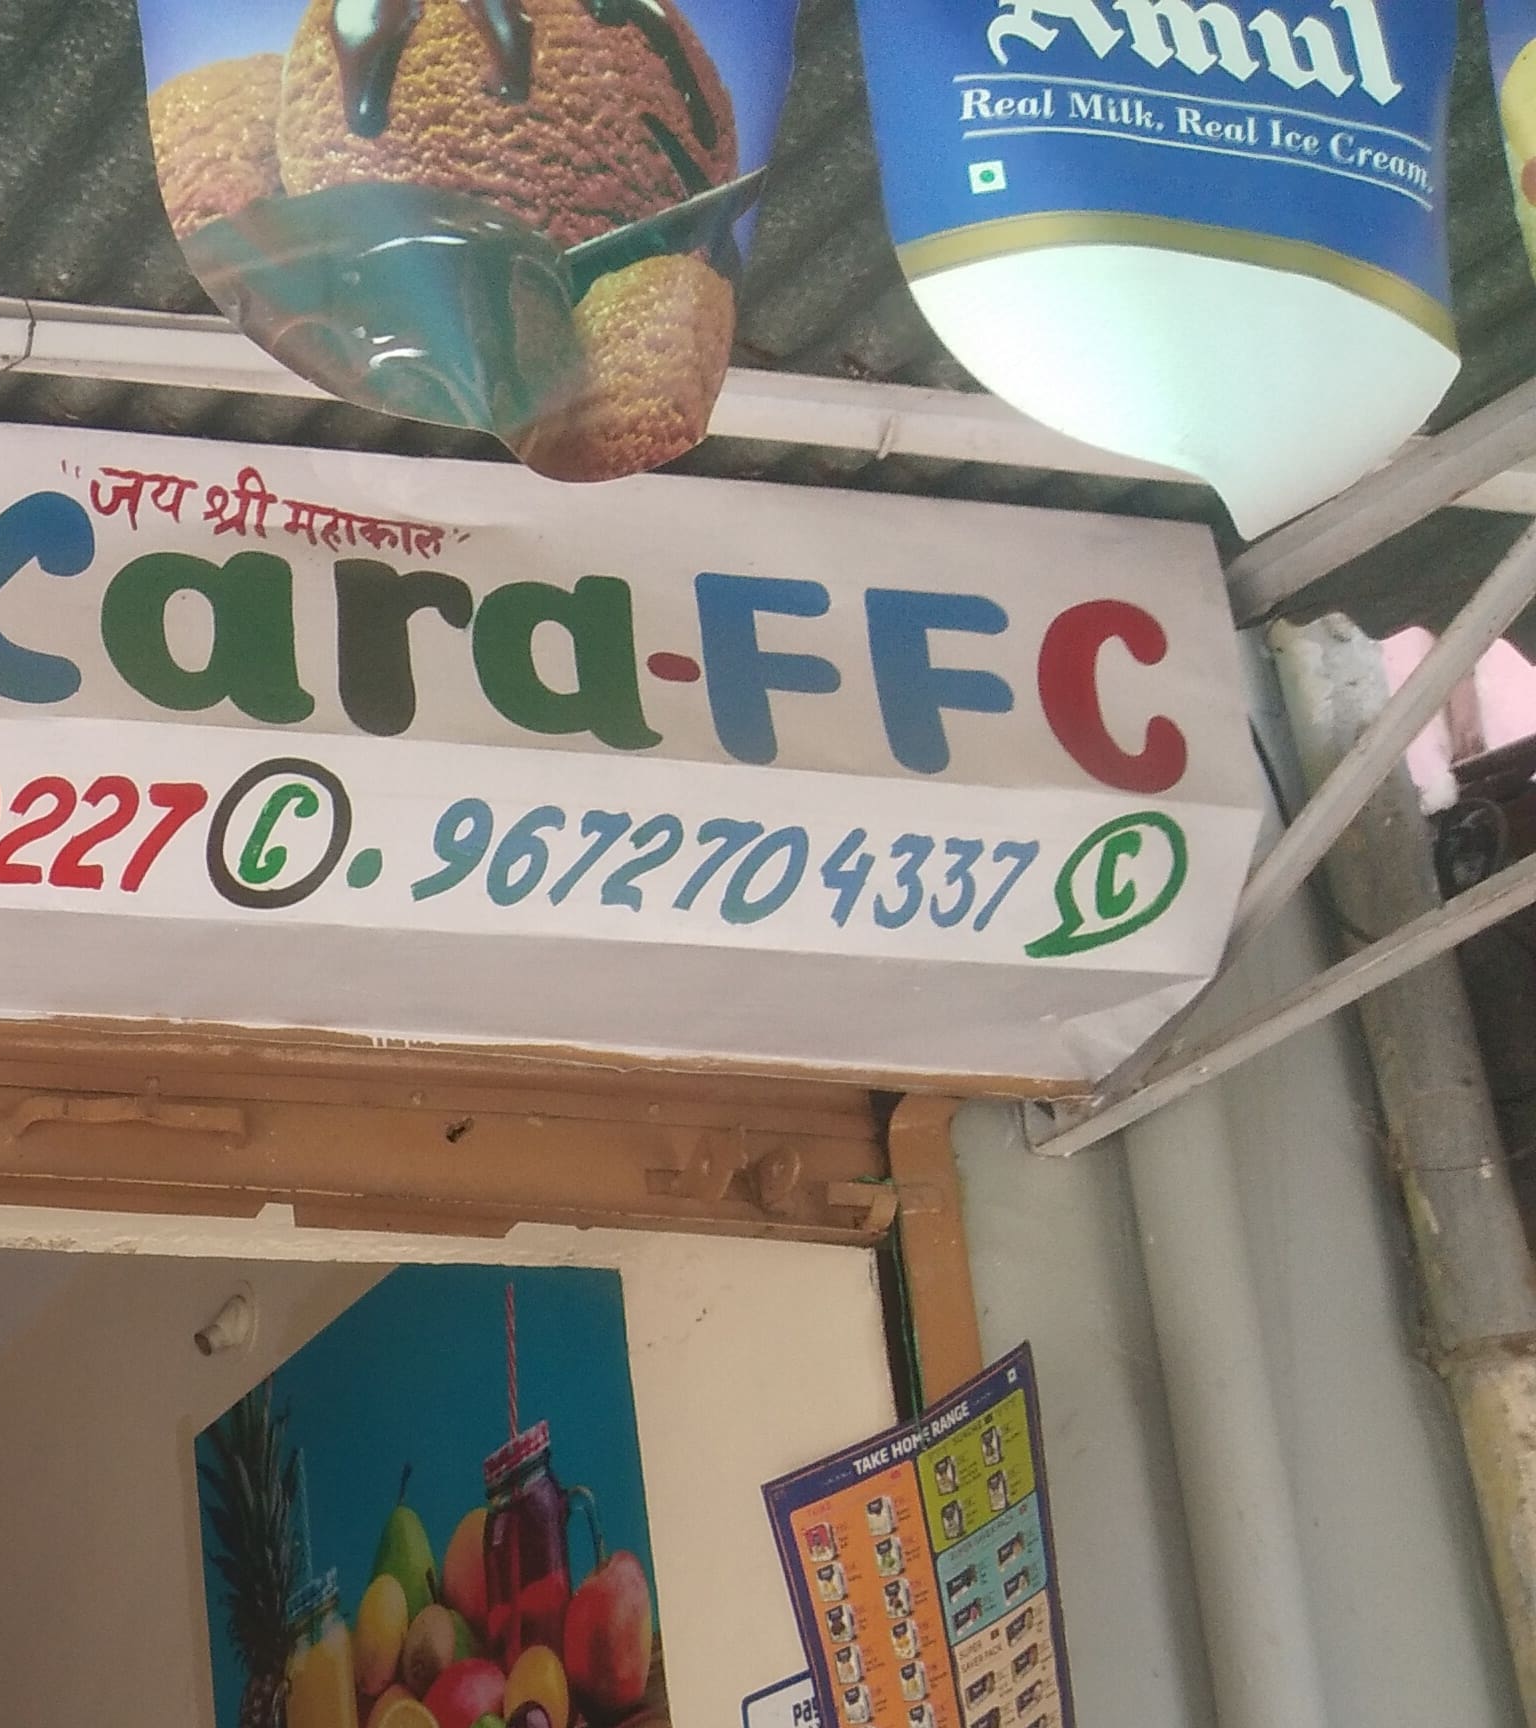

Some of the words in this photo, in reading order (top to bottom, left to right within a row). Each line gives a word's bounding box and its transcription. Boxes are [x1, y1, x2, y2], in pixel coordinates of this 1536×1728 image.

[959, 88, 1055, 120] Real
[1175, 106, 1259, 145] Real
[1268, 119, 1320, 156] Ice
[203, 466, 277, 538] श्री
[412, 798, 1040, 932] 9672704337
[852, 1448, 890, 1476] TAKE
[931, 1401, 970, 1437] RANGE
